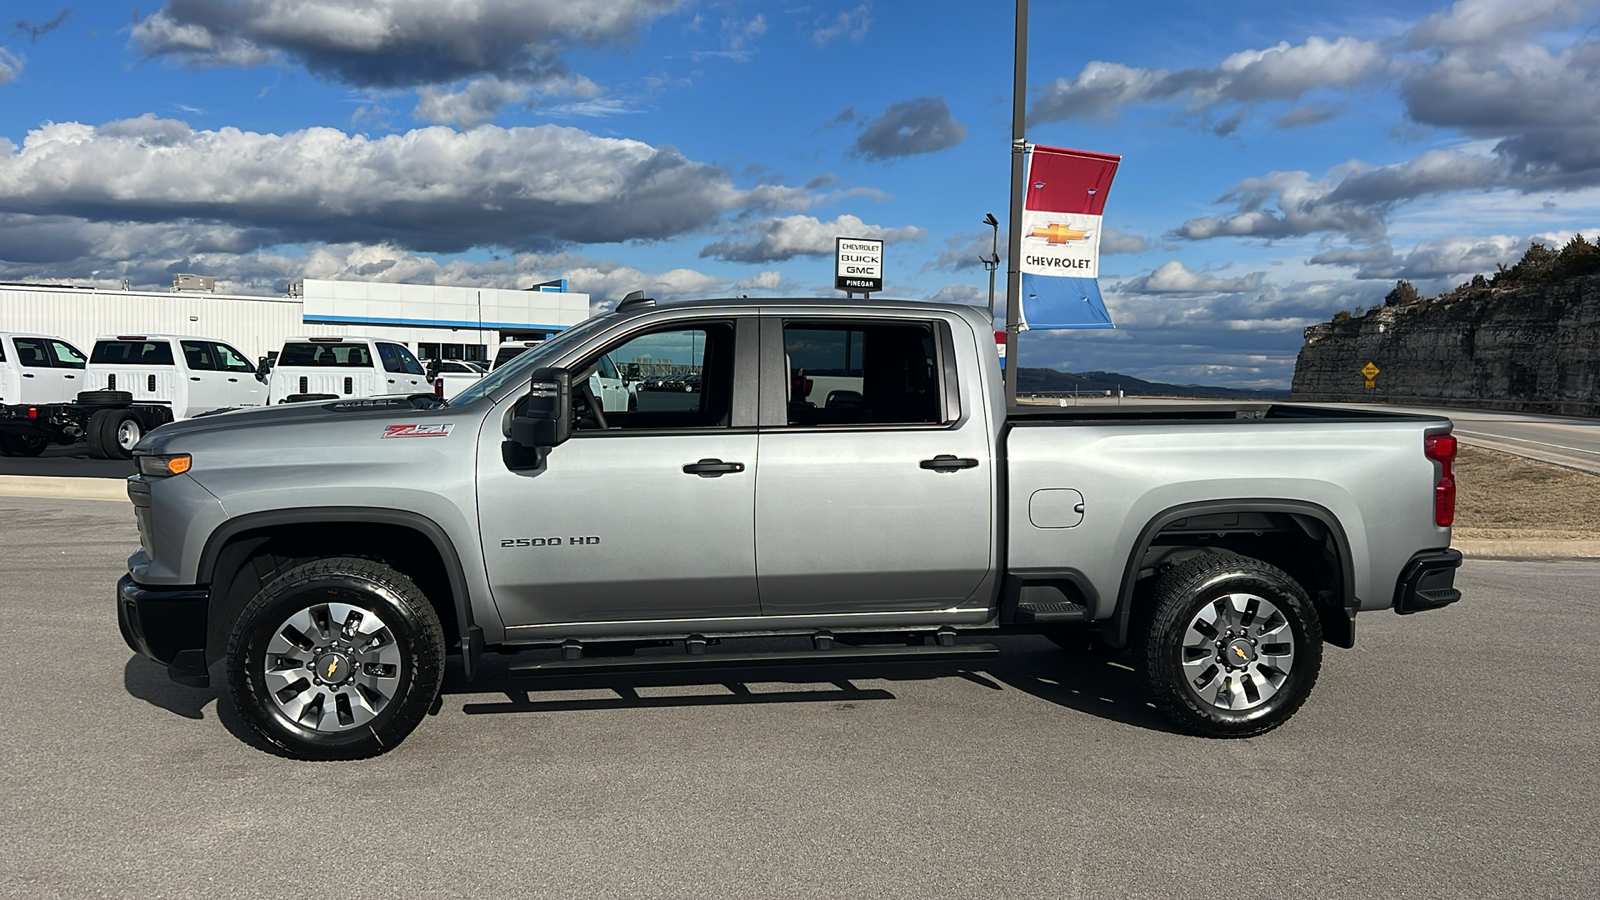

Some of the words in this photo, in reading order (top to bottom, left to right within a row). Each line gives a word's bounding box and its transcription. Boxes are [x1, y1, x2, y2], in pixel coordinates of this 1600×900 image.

[842, 243, 880, 252] CHEVROLET
[841, 254, 879, 264] BUICK
[1026, 255, 1090, 268] CHEVROLET
[846, 266, 874, 274] GMC
[846, 280, 874, 288] PINEGAR
[381, 423, 455, 439] Z71
[500, 537, 562, 548] 2500
[569, 536, 601, 546] HD
